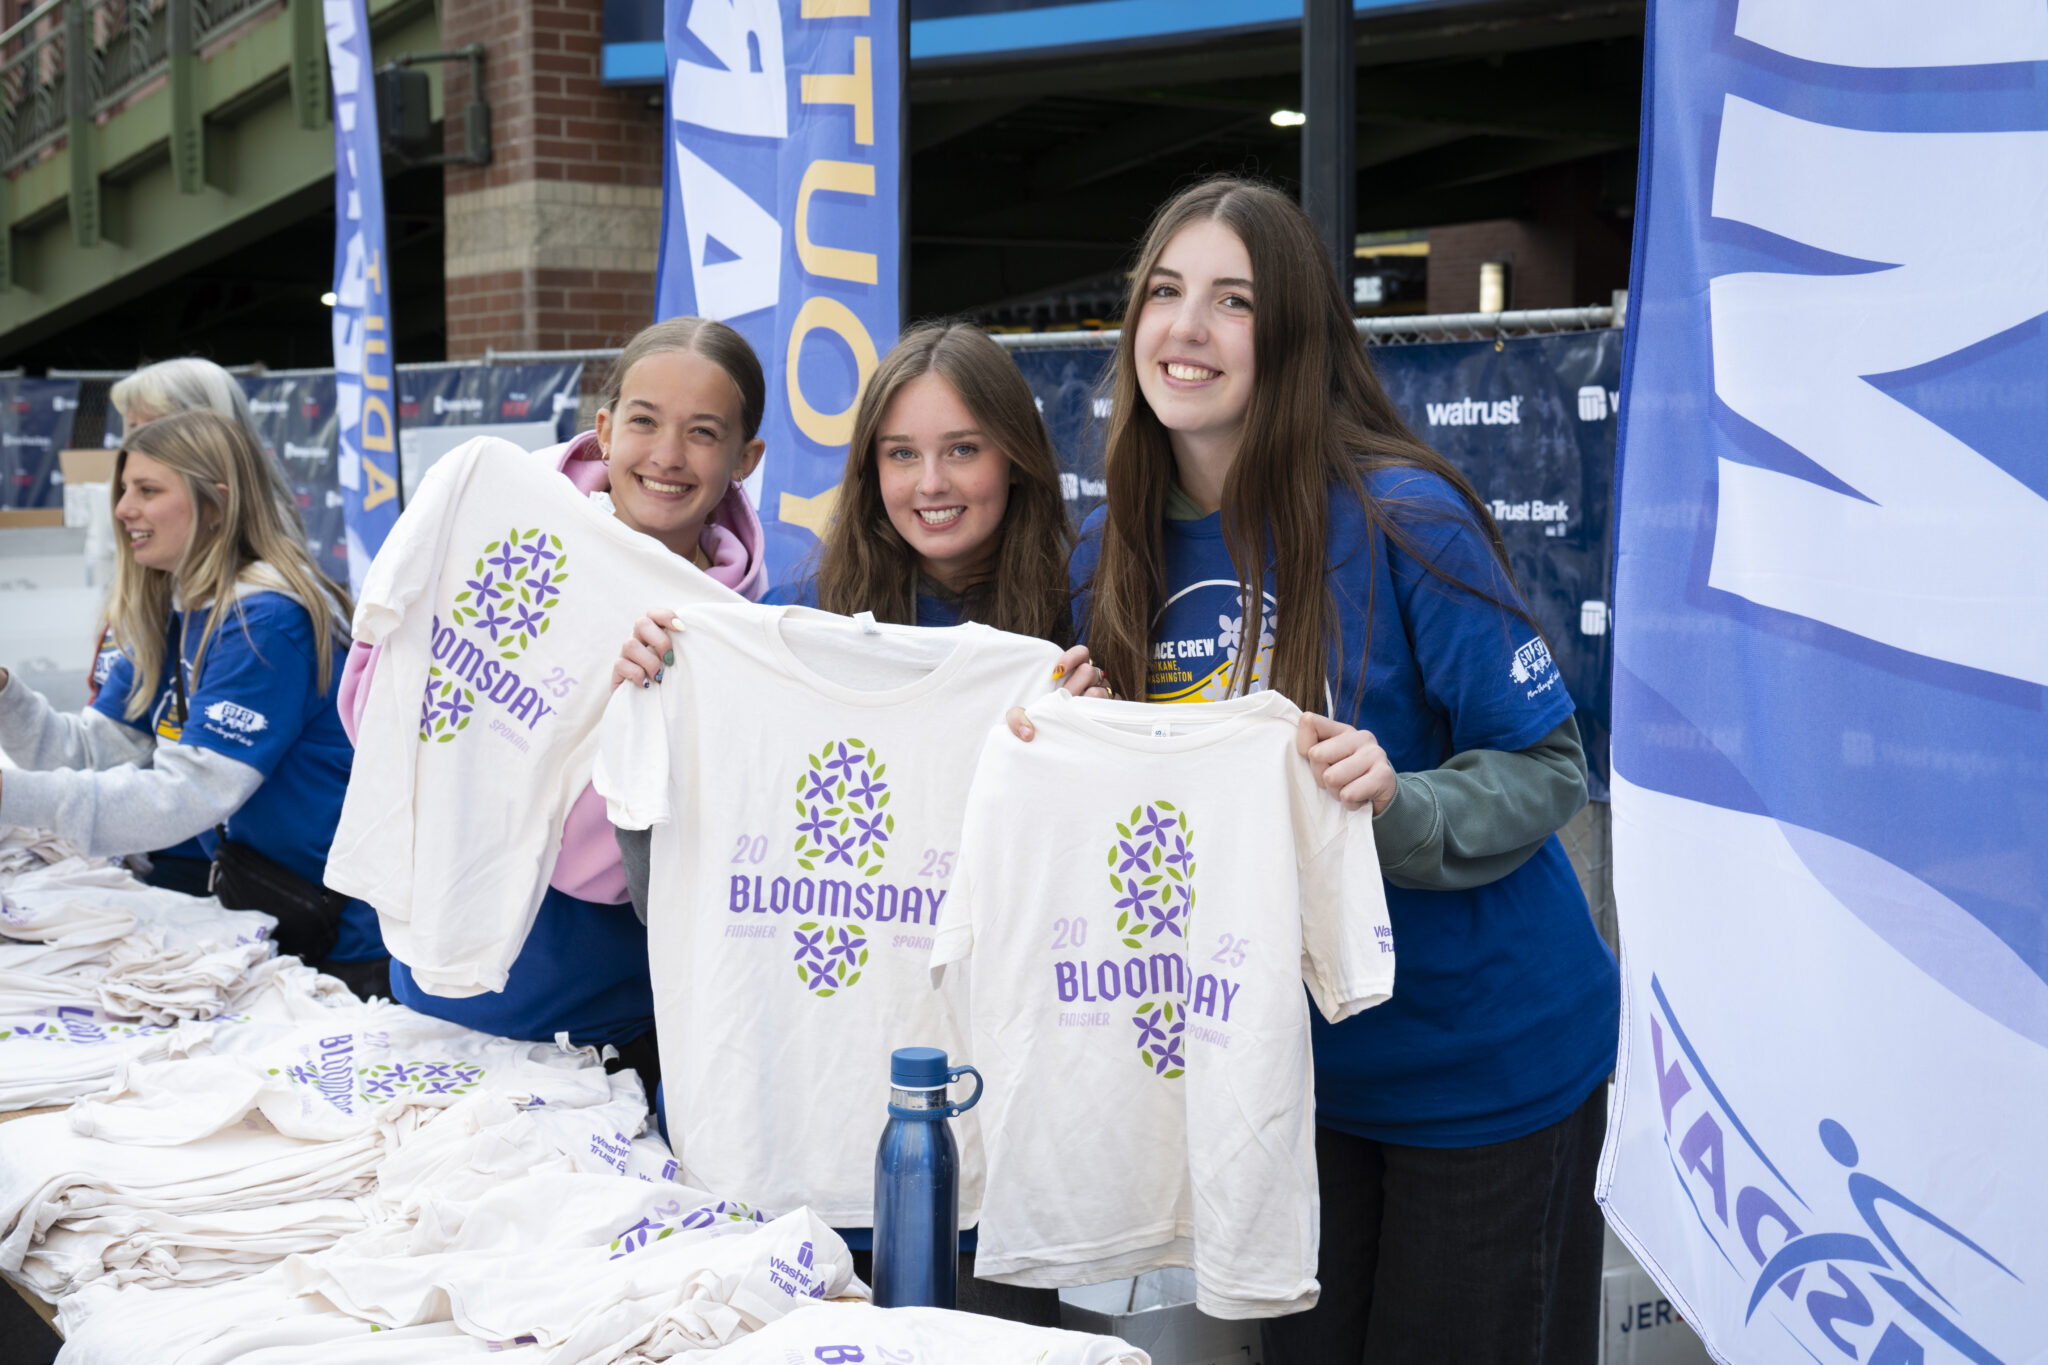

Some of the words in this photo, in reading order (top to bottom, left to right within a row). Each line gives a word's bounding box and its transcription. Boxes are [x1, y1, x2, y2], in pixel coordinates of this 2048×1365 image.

[1492, 500, 1530, 521] Trust
[1532, 500, 1569, 521] Bank
[1152, 640, 1175, 660] ACE
[1178, 638, 1214, 658] CREW
[542, 666, 578, 699] 25
[730, 834, 769, 865] 20
[918, 848, 956, 880] 25
[729, 874, 947, 926] BLOOMSDAY
[725, 924, 777, 939] FINISHER
[1051, 916, 1088, 950] 20
[1211, 933, 1251, 969] 25
[1058, 1011, 1111, 1028] FINISHER
[769, 1270, 798, 1298] Trust
[1621, 1298, 1684, 1333] JER
